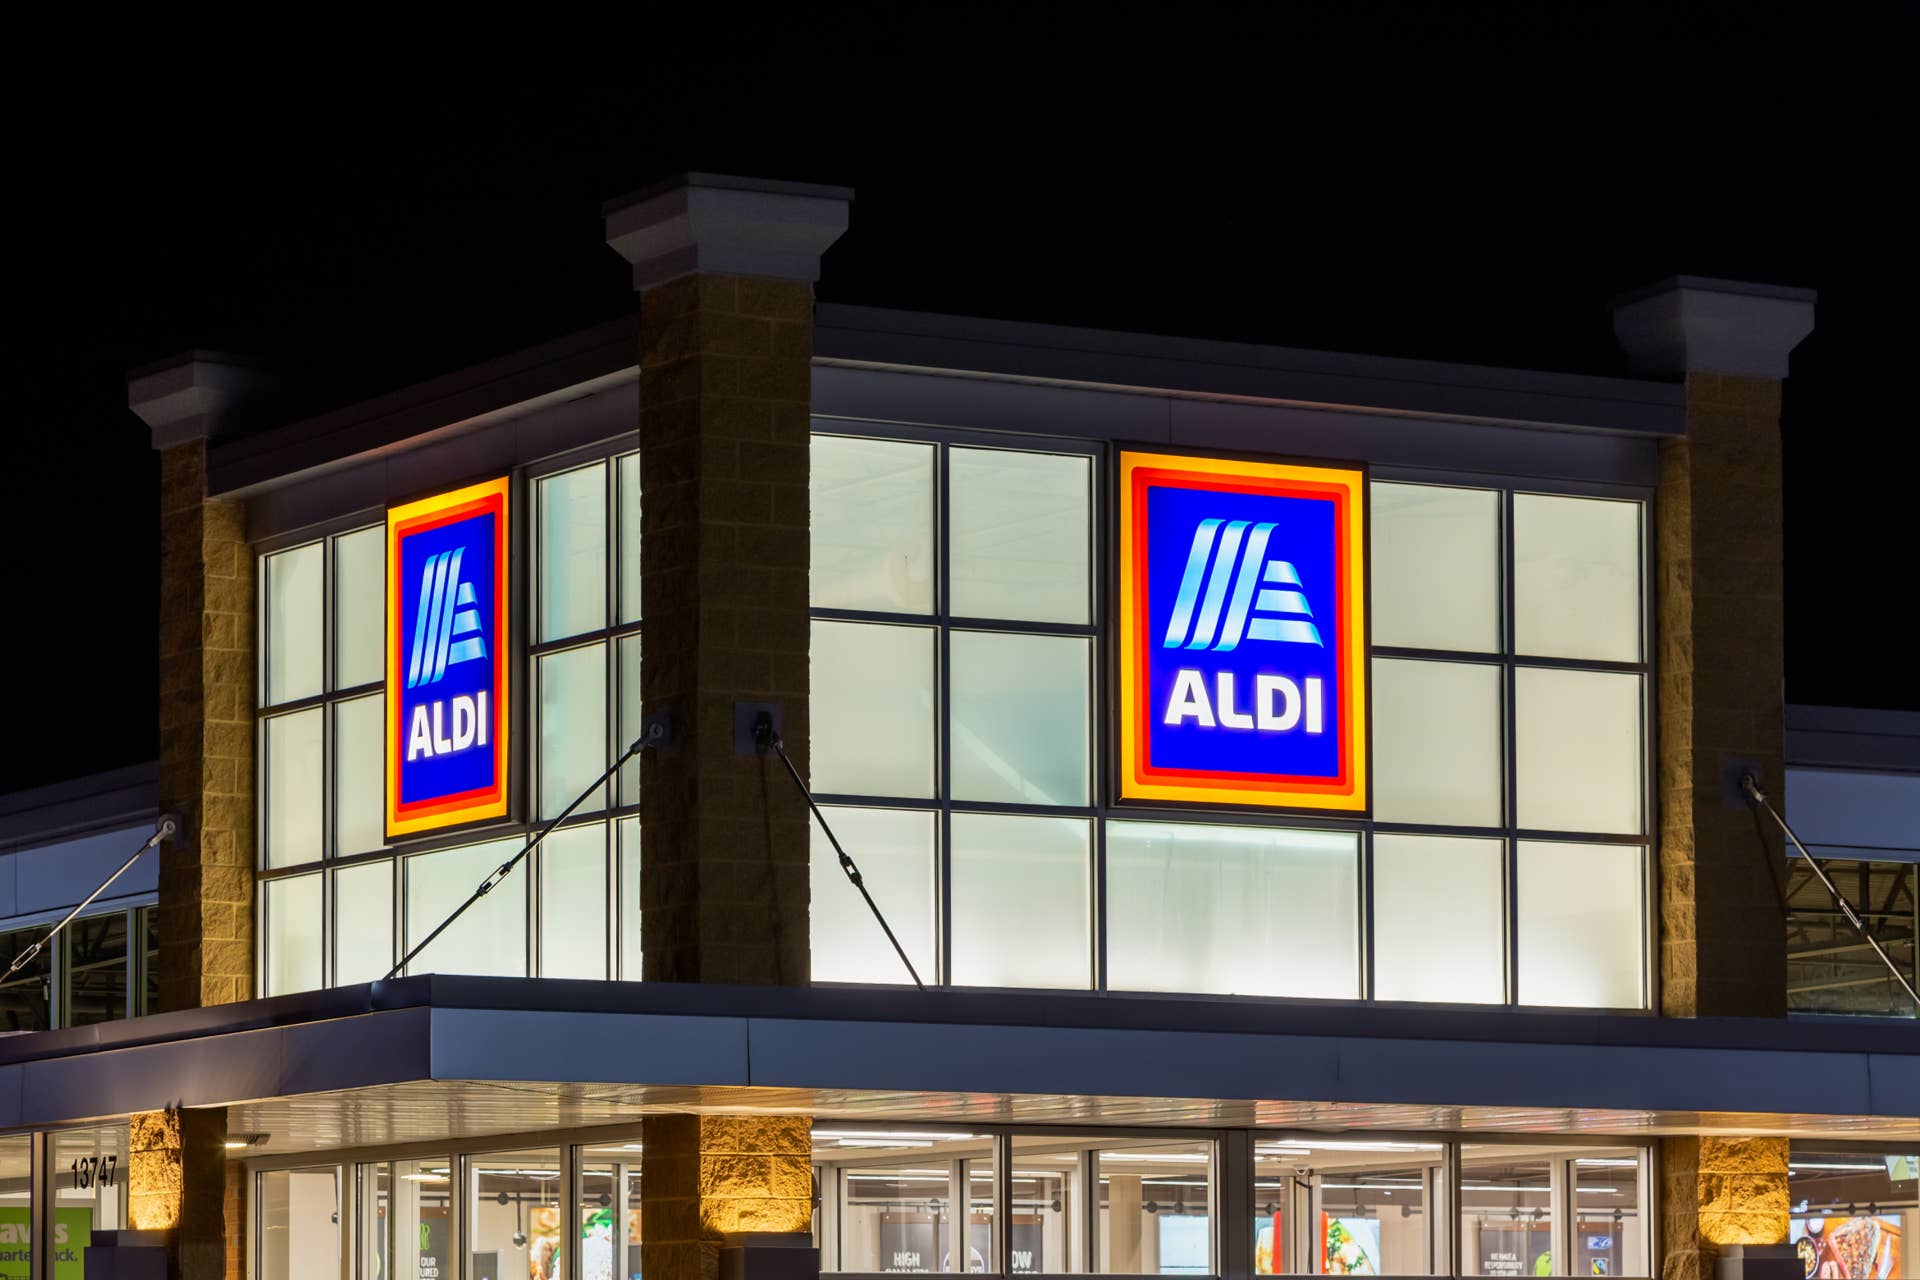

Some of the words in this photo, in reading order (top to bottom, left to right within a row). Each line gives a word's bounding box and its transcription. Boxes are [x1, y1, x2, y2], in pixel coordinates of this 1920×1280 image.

[1164, 669, 1323, 735] ALDI
[407, 690, 487, 762] ALDI
[71, 1155, 118, 1190] 13747
[420, 1256, 437, 1267] OUR
[893, 1251, 921, 1267] HIGH
[1012, 1250, 1033, 1269] OW
